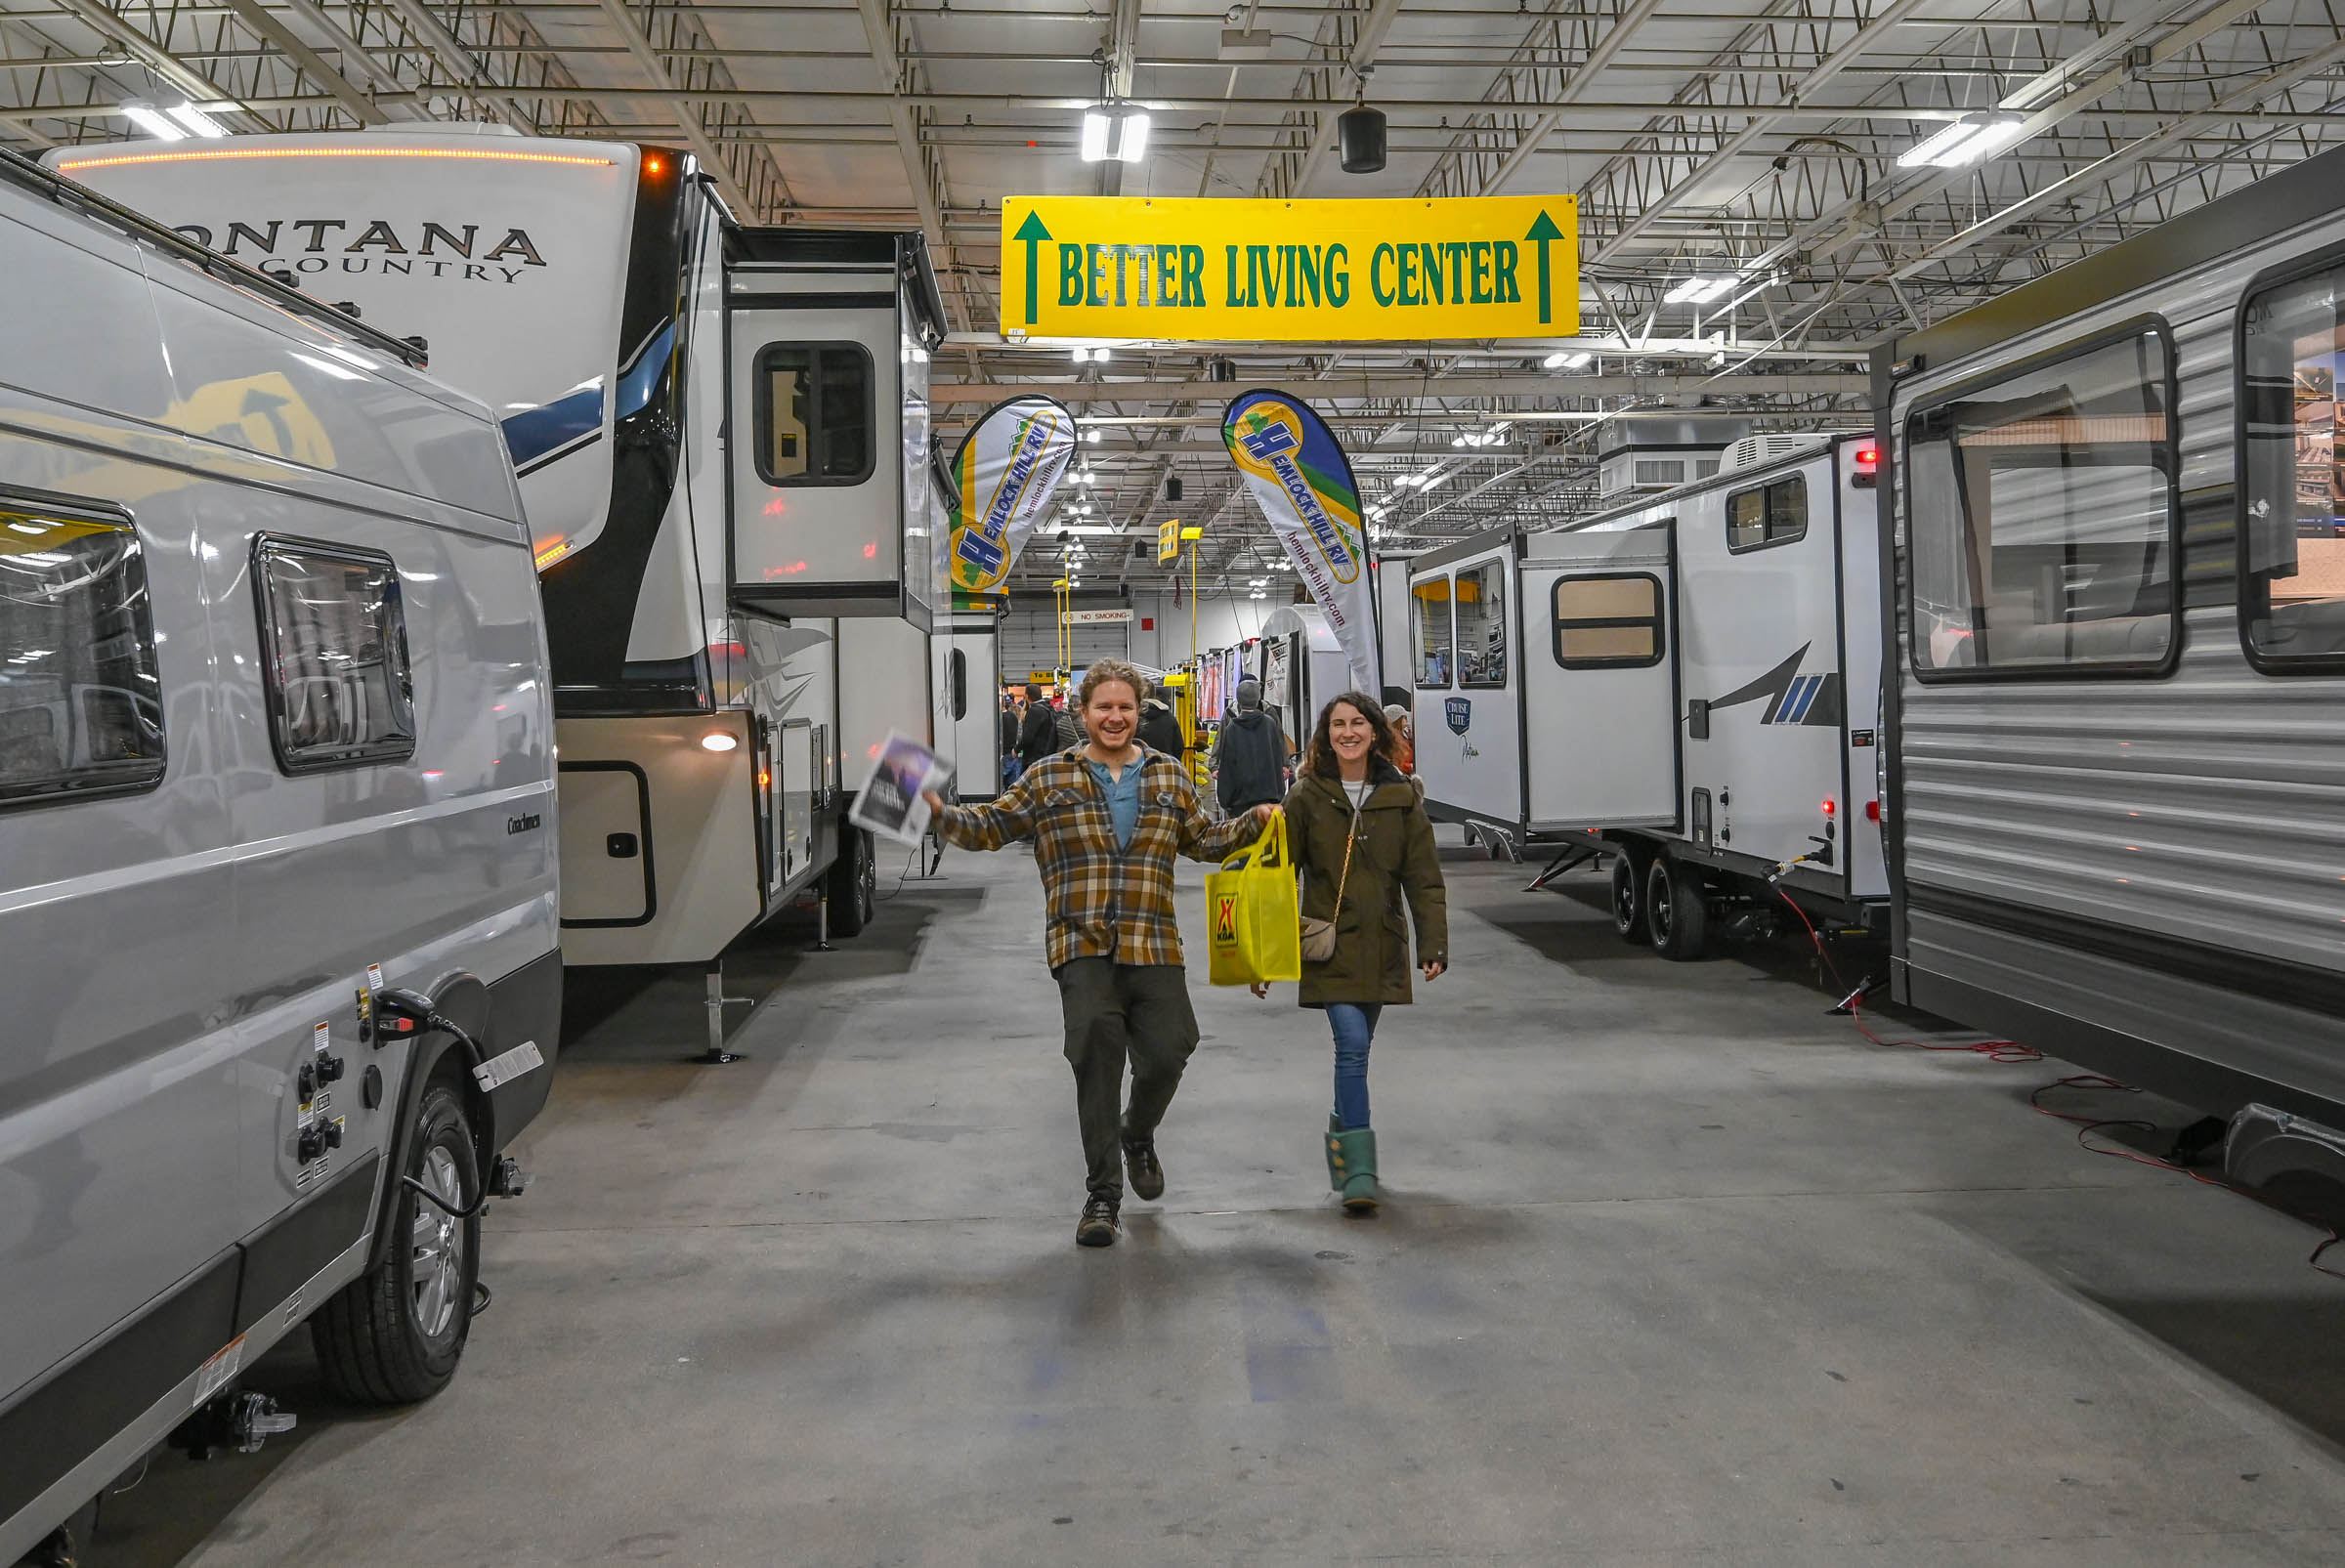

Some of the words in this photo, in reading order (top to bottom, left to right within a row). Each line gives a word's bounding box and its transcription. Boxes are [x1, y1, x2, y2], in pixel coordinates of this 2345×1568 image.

[257, 257, 526, 284] COUNTRY
[1058, 242, 1207, 308] BETTER
[1225, 242, 1350, 309] LIVING
[1371, 240, 1521, 308] CENTER
[1011, 446, 1038, 483] HILL
[1027, 424, 1047, 455] RV
[1024, 441, 1068, 519] hemlockhillrv.com
[1306, 511, 1340, 550] HILL
[1326, 541, 1352, 569] RV
[1286, 530, 1346, 627] hemlockhillrv.com
[1451, 713, 1466, 726] LITE
